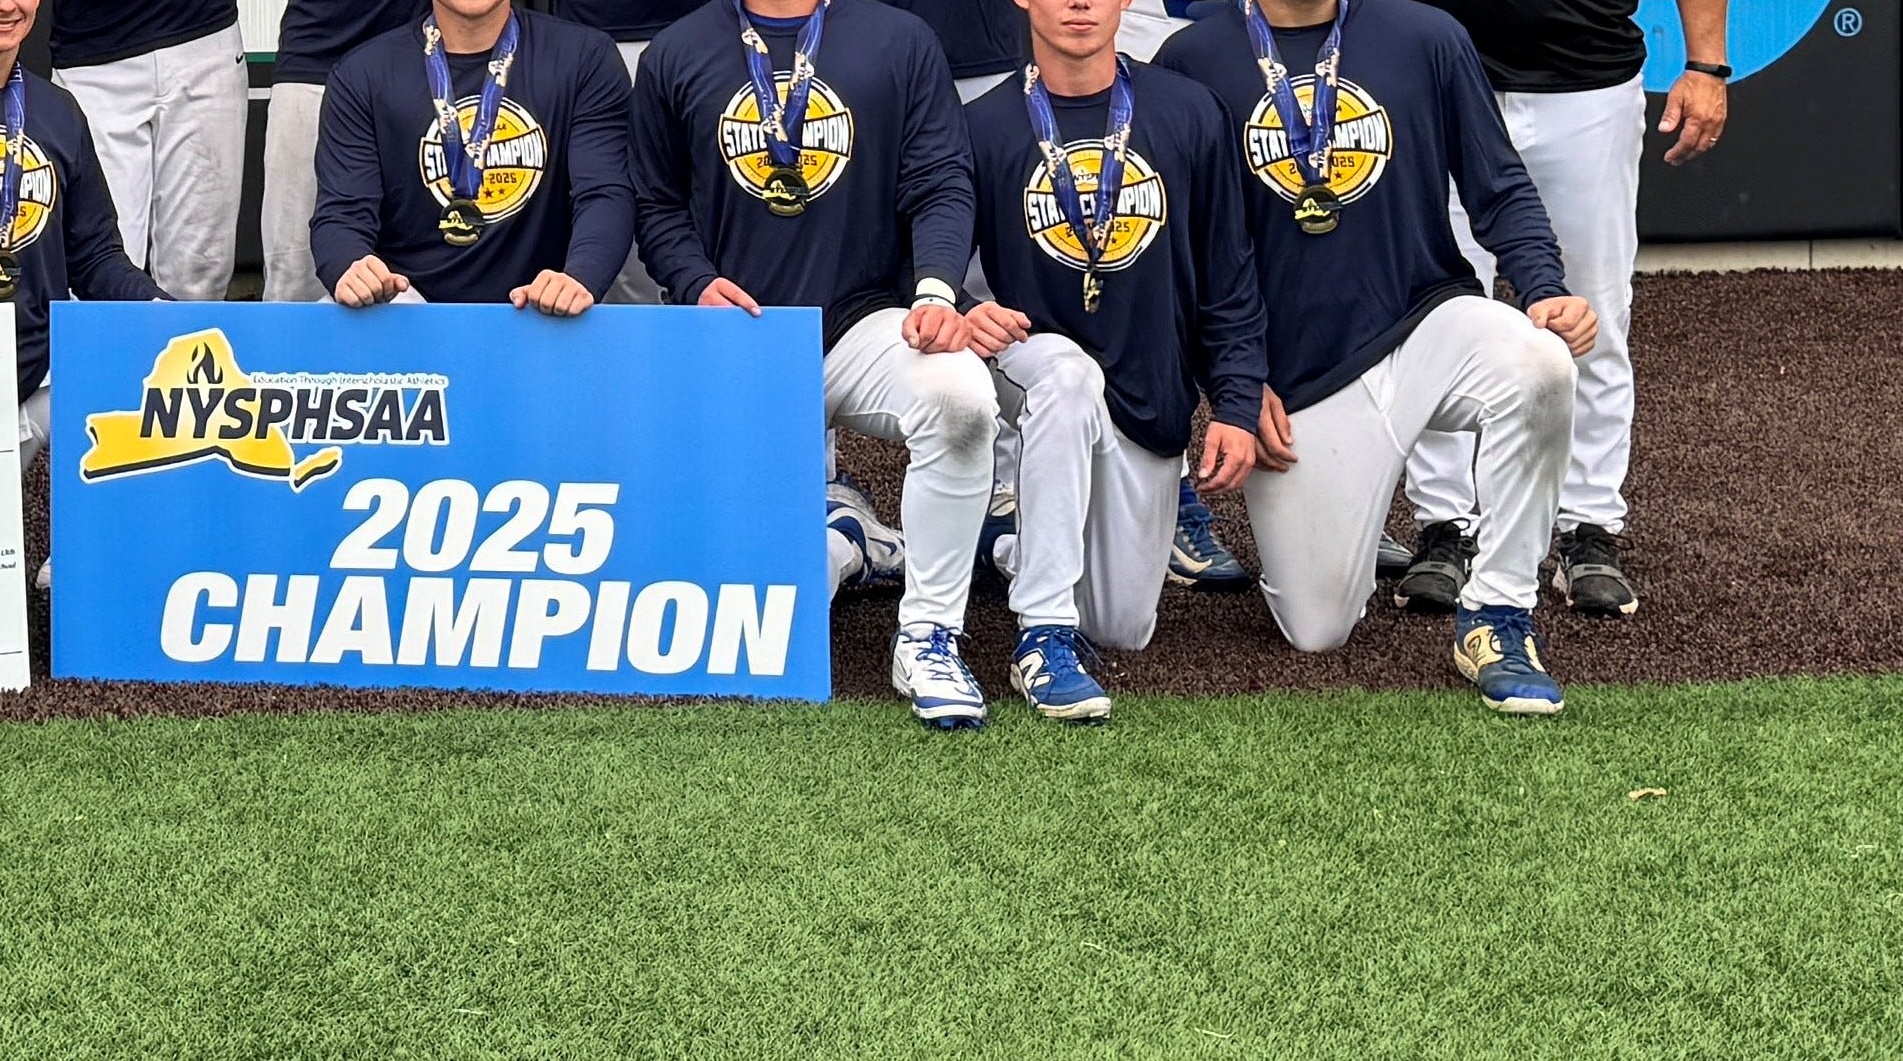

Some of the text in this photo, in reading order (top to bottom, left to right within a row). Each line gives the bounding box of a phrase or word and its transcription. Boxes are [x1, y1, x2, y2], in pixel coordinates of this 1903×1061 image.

[486, 133, 544, 167] AMPION
[802, 122, 848, 156] MPION
[1249, 128, 1290, 165] STAT
[1334, 111, 1387, 152] MPION
[253, 375, 297, 385] Education
[299, 375, 338, 386] Through
[406, 377, 446, 386] Athletics
[139, 386, 447, 441] NYSPHSAA
[329, 478, 620, 575] 2025
[159, 571, 798, 677] CHAMPION
